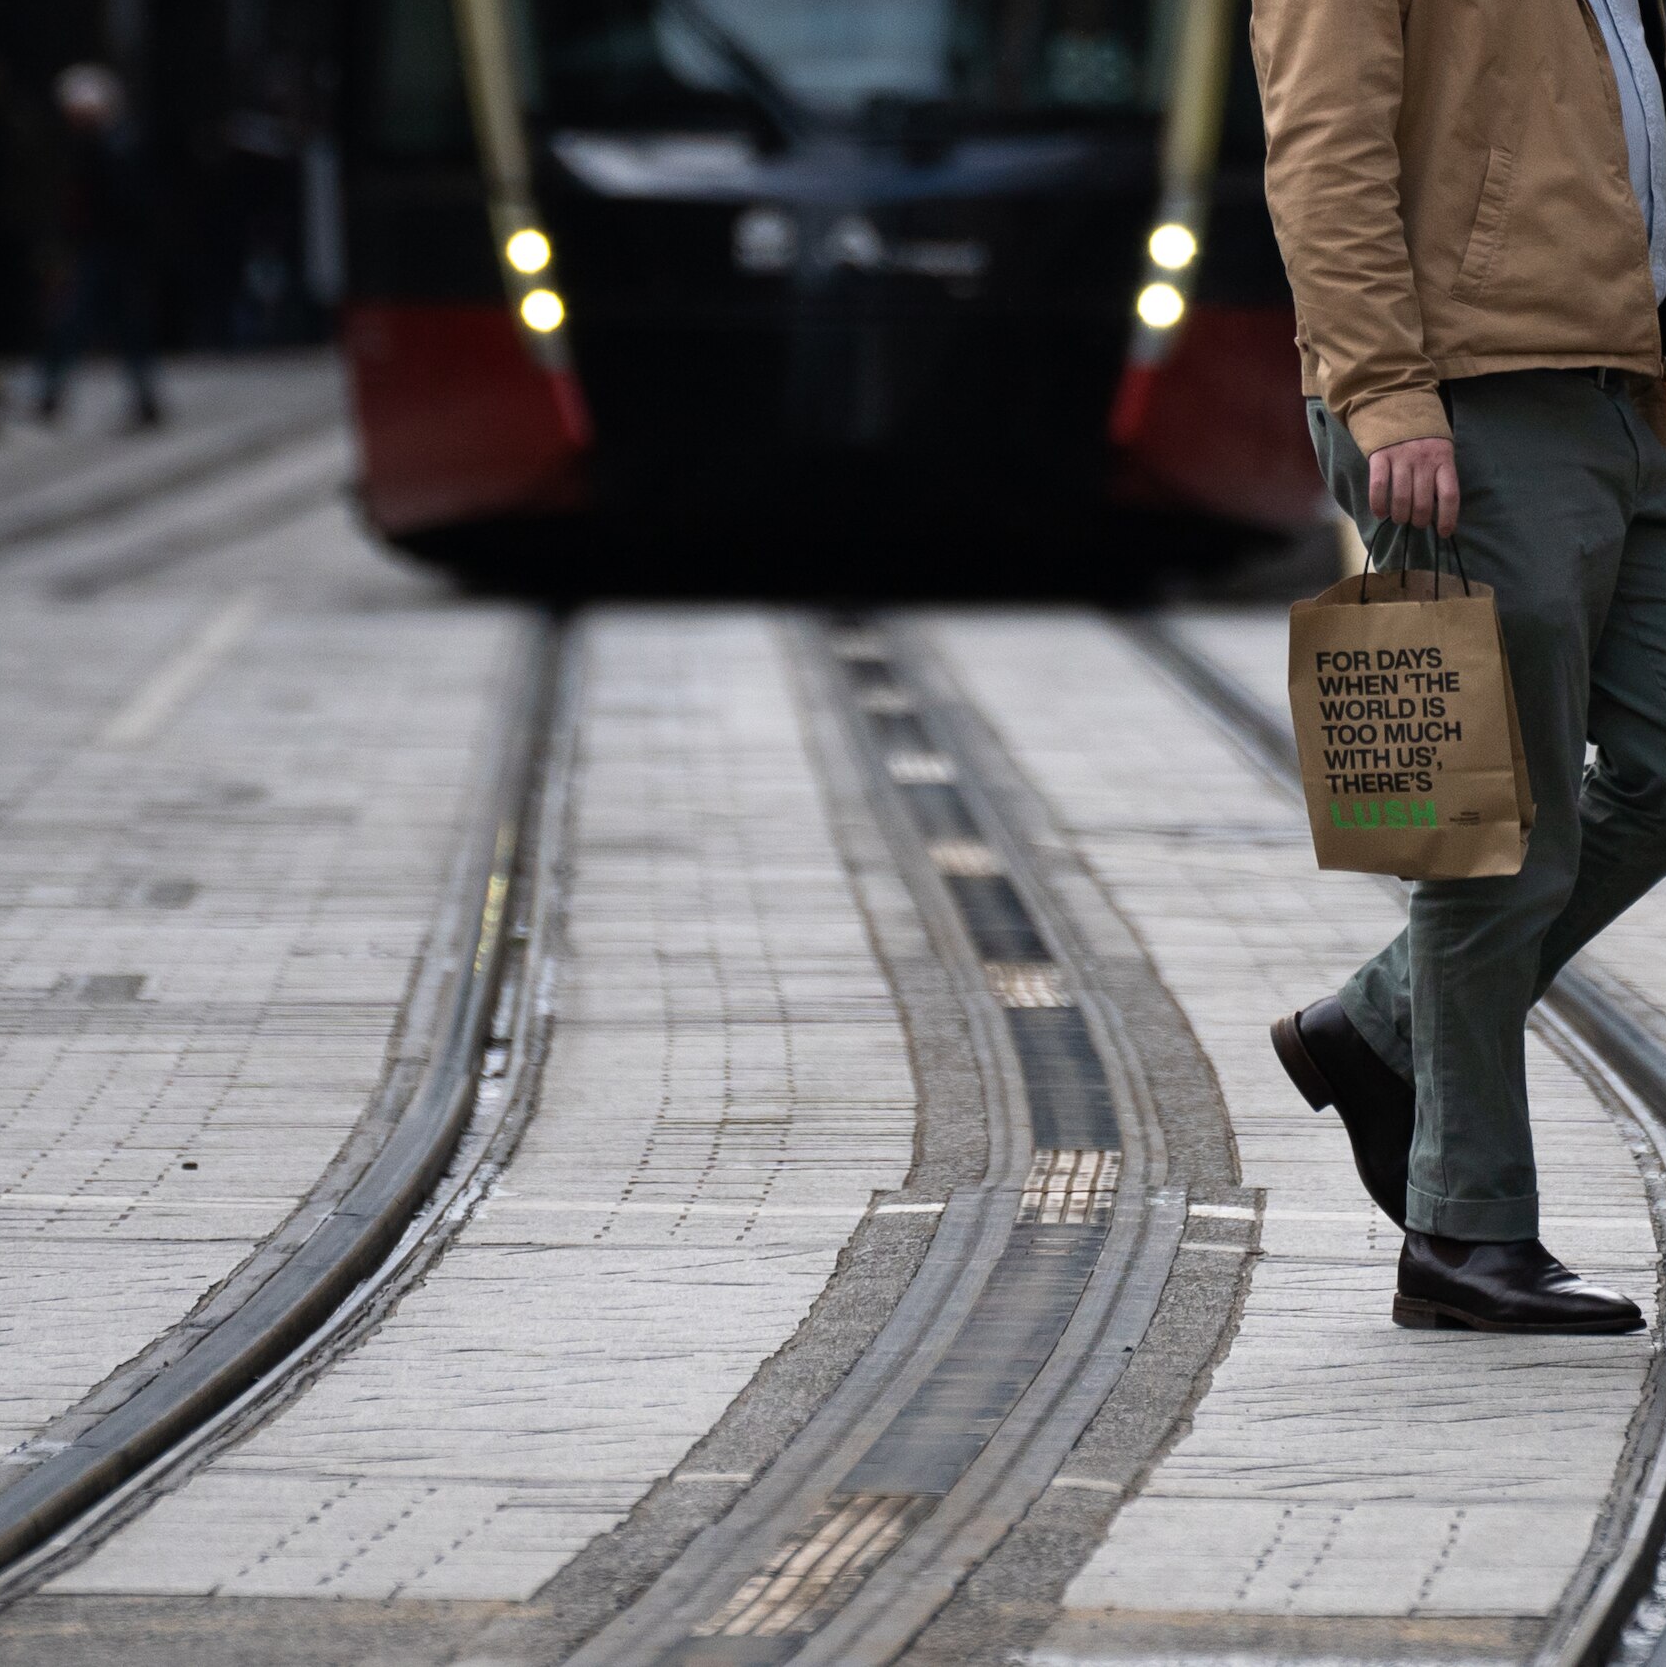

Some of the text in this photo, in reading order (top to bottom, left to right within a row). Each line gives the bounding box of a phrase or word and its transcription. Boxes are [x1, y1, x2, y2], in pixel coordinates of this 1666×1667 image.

[1316, 647, 1443, 673] FOR DAYS
[1317, 674, 1399, 697] WHEN
[1319, 696, 1446, 722] WORLD IS
[1321, 721, 1463, 746] TOO MUCH
[1323, 748, 1391, 771] WITH
[1329, 798, 1438, 829] LUSH
